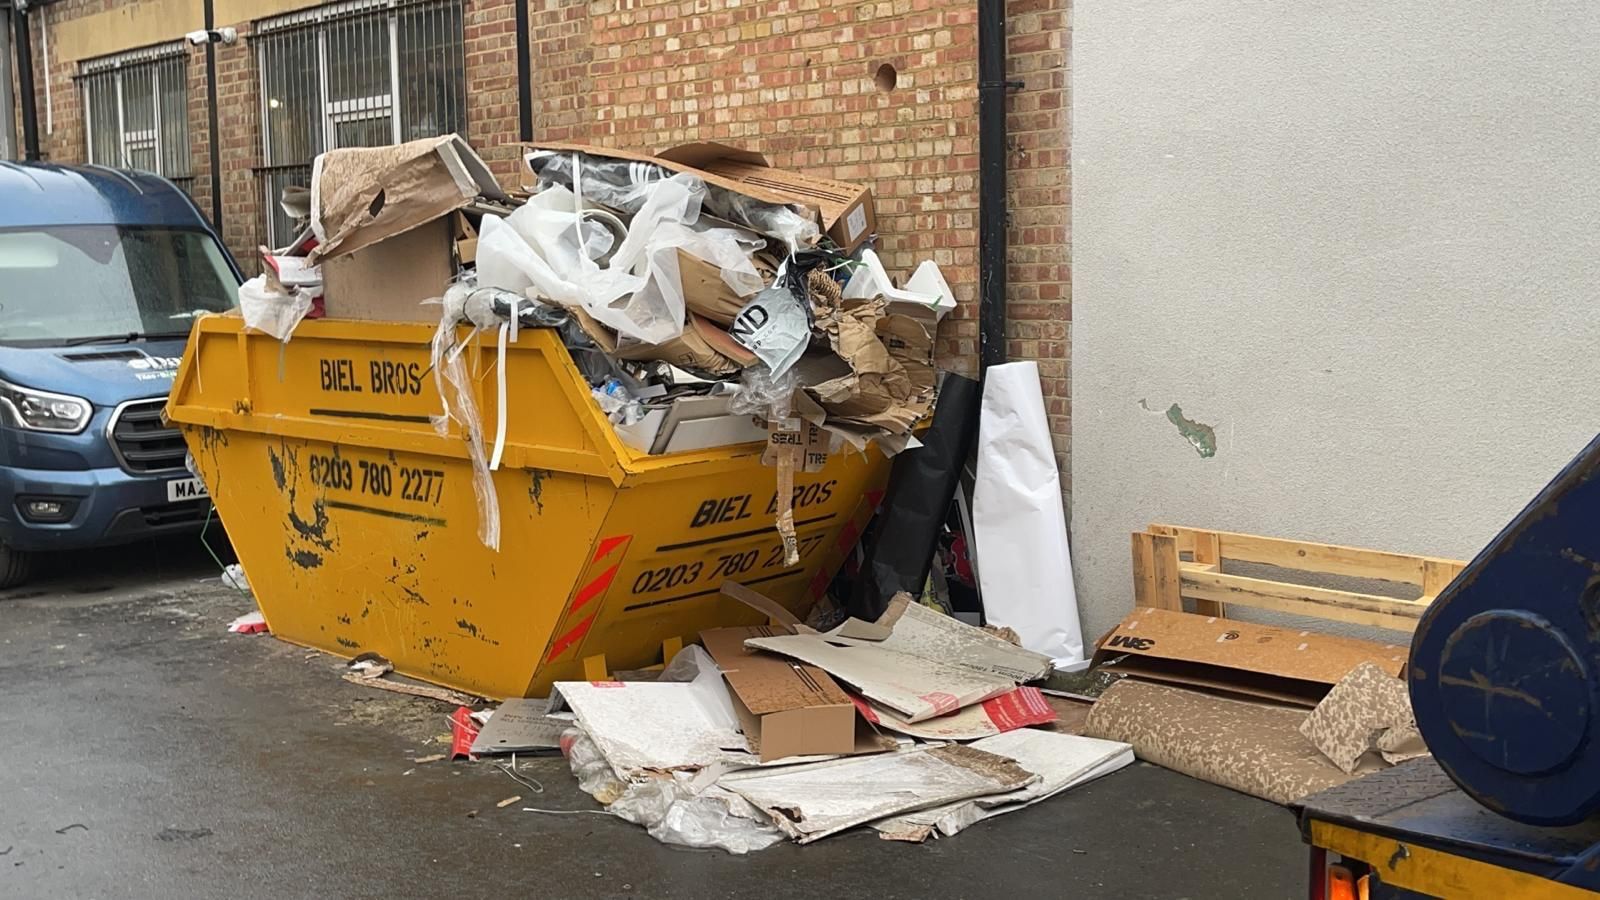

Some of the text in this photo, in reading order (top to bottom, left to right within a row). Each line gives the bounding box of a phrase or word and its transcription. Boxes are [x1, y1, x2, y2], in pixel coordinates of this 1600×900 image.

[320, 359, 421, 395] BIEL BROS
[771, 432, 803, 445] TRES
[310, 454, 444, 503] 0203 780 2277
[690, 494, 752, 528] BIEL
[632, 534, 825, 594] 0203 780 277
[1108, 635, 1156, 650] 3M
